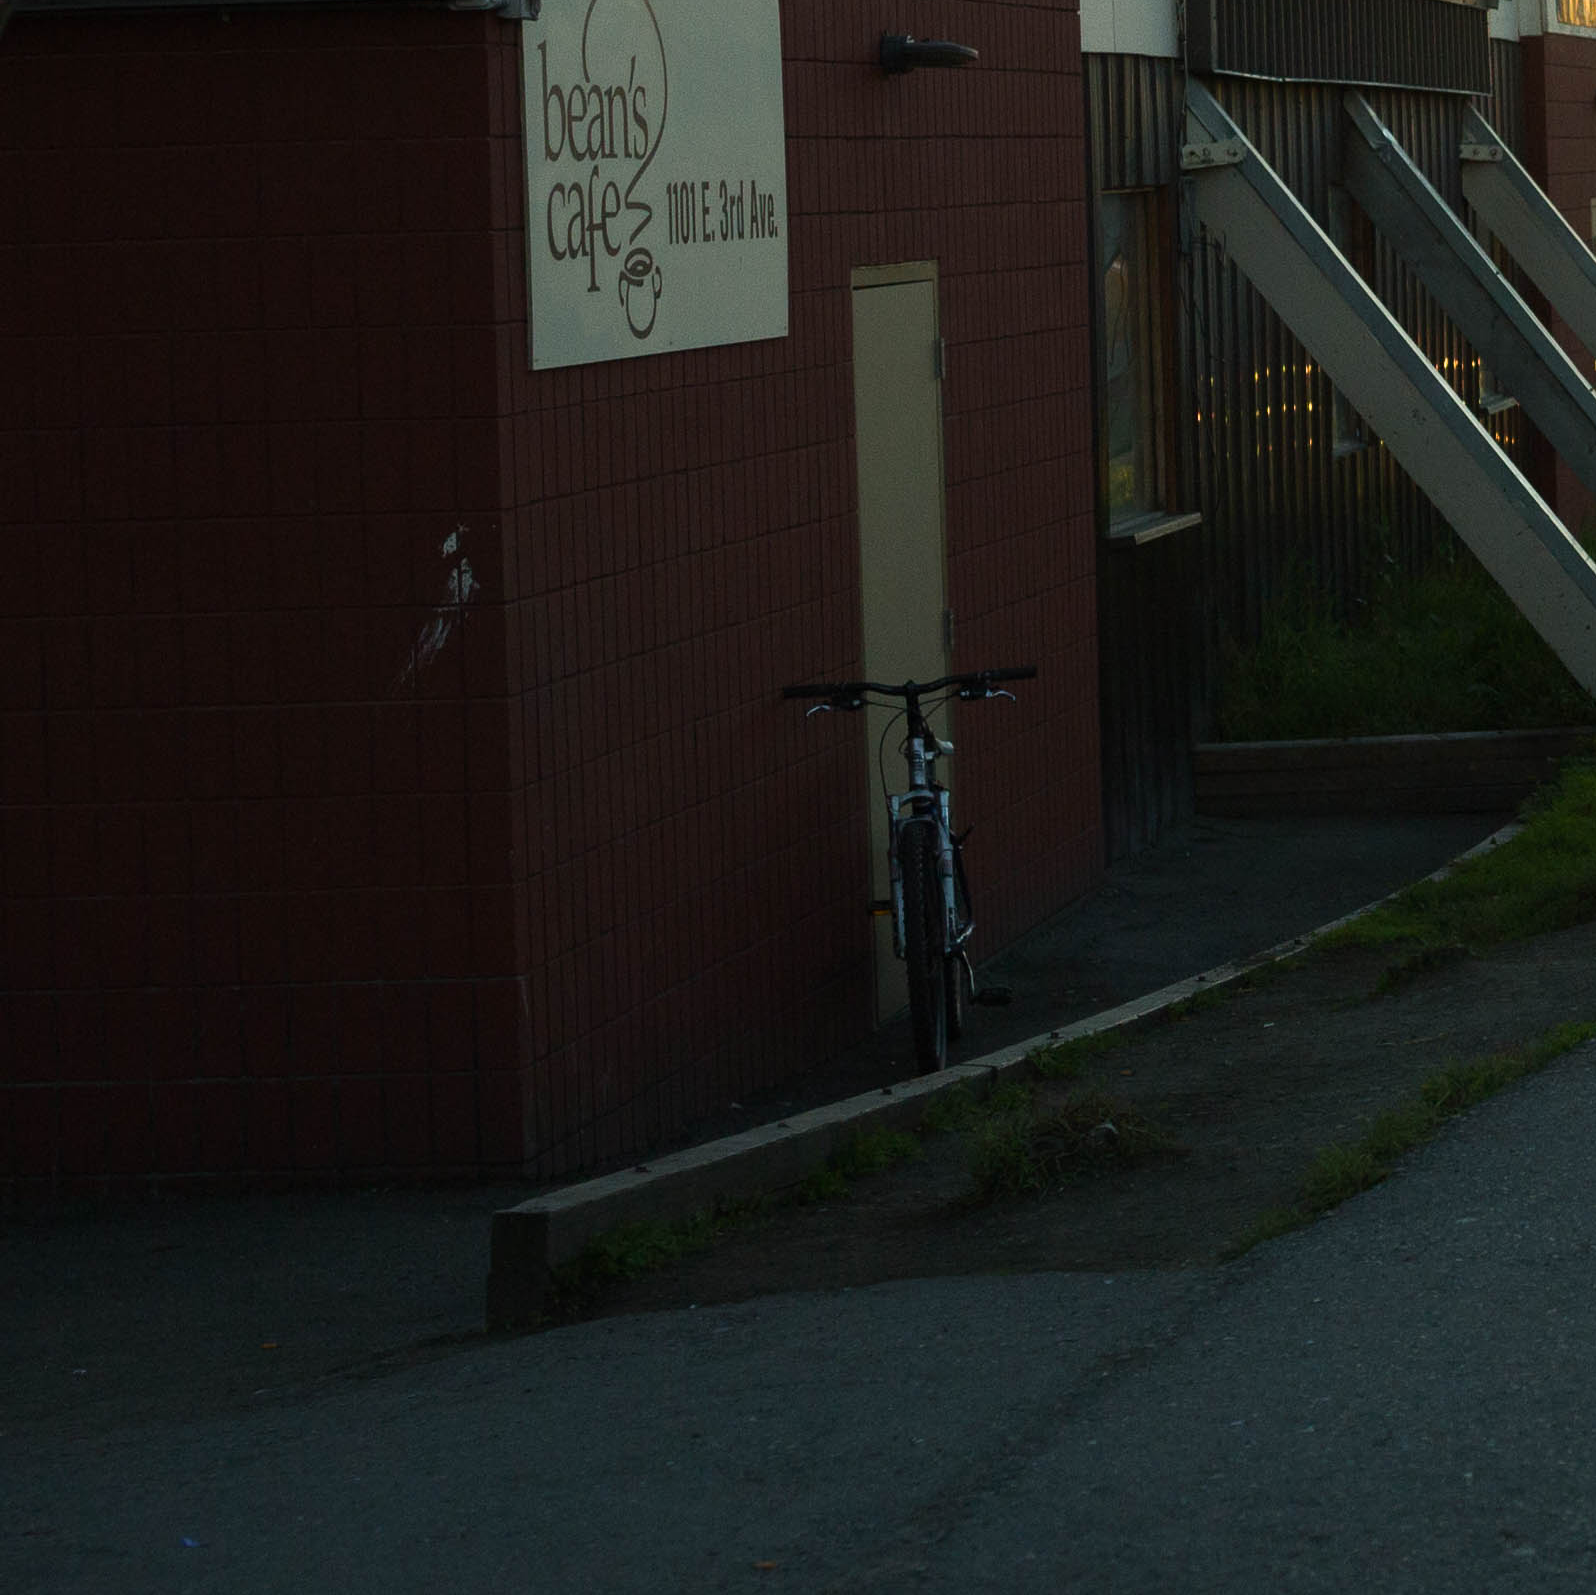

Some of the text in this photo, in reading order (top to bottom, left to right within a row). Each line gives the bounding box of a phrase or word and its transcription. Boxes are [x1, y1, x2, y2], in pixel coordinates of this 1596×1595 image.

[537, 40, 649, 161] bean's
[547, 166, 621, 292] cafe
[666, 179, 778, 244] 1101 E. 3rd Ave.
